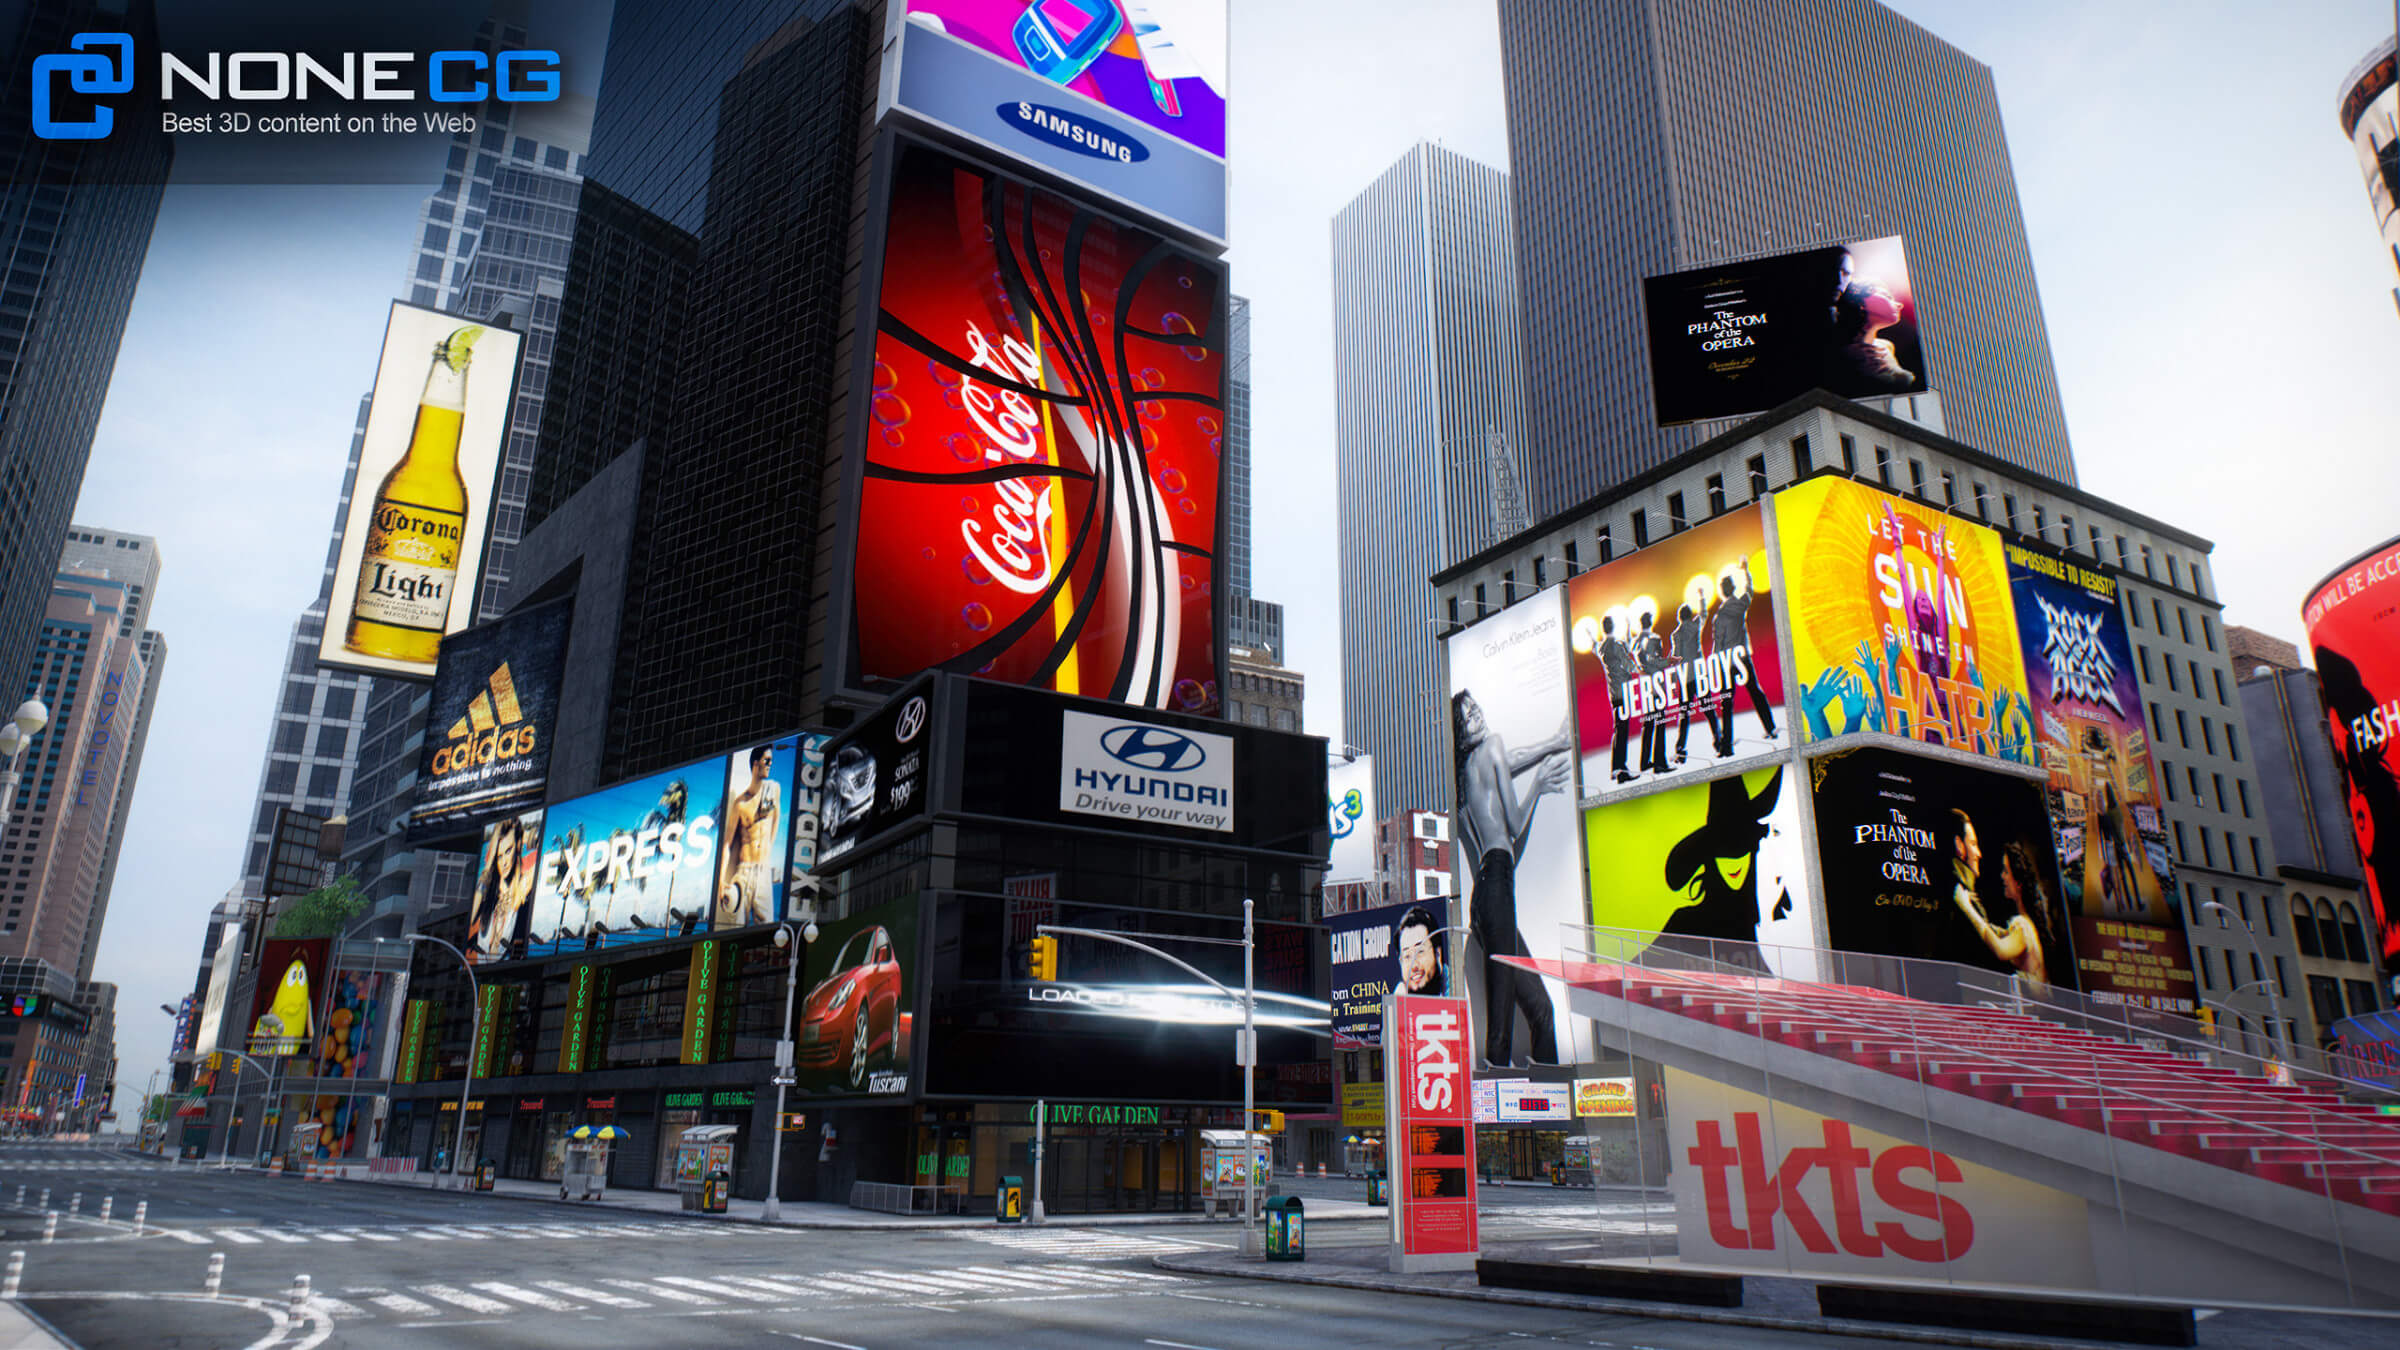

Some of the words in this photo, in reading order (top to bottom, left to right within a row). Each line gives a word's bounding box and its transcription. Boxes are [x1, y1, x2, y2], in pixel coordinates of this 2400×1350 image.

[1018, 101, 1132, 163] SAMSUNG
[1687, 313, 1768, 336] PHANTOM
[1713, 311, 1735, 321] The
[1713, 329, 1725, 339] of
[1726, 328, 1742, 338] the
[1701, 335, 1756, 351] OPERA
[377, 506, 460, 541] Corona
[1866, 513, 1905, 545] LET
[1917, 530, 1957, 561] THE
[369, 561, 444, 601] Light
[1874, 552, 1968, 629] SUN
[2066, 563, 2079, 585] TO
[2321, 584, 2349, 612] WILL
[2346, 570, 2366, 597] BE
[1883, 622, 1946, 657] SHINE
[1953, 641, 1976, 665] IN
[1617, 662, 1689, 721] JERSEY
[1693, 644, 1749, 699] BOYS
[1879, 661, 2000, 757] HAIR
[2351, 698, 2400, 753] FASH
[78, 671, 124, 806] NOVOTEL
[432, 724, 536, 775] adidas
[493, 759, 532, 775] nothing
[890, 781, 911, 812] $199
[1075, 768, 1227, 807] HYUNDAI
[1075, 793, 1132, 814] Drive
[1136, 804, 1182, 821] your
[1186, 811, 1227, 829] way
[1889, 808, 1909, 824] The
[540, 815, 715, 896] EXPRESS
[1853, 824, 1936, 850] PHANTOM
[1893, 845, 1903, 860] of
[1903, 846, 1918, 861] the
[1881, 861, 1931, 886] OPERA
[1362, 924, 1391, 960] GROUP
[699, 940, 713, 990] OLIVE
[577, 965, 589, 1009] OLIVE
[1351, 980, 1390, 998] CHINA
[1343, 1000, 1382, 1016] Training
[568, 1011, 583, 1072] GARDEN
[692, 993, 707, 1063] GARDEN
[1415, 1009, 1462, 1112] tkts
[868, 1072, 908, 1094] Tuscani
[1582, 1081, 1626, 1098] GRAND
[1577, 1099, 1634, 1114] OPENING
[1687, 1111, 1975, 1264] tkts
